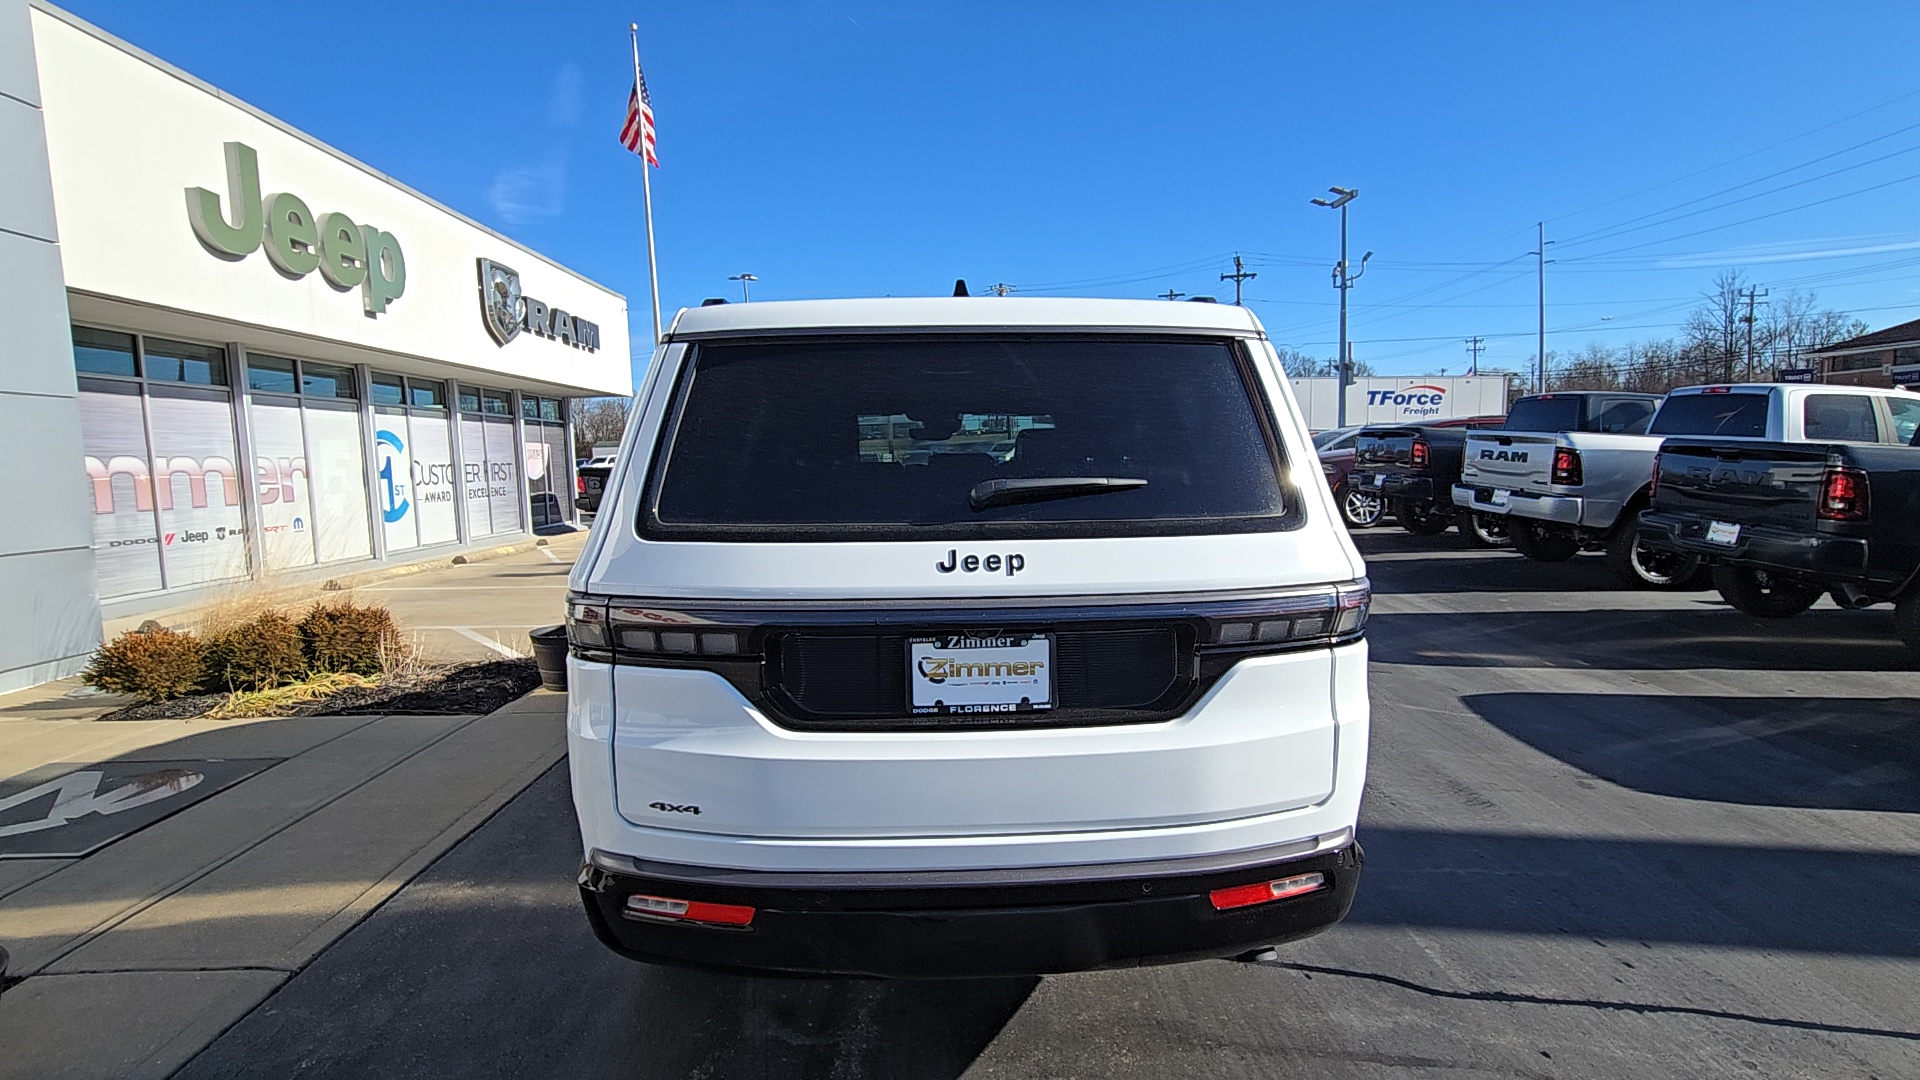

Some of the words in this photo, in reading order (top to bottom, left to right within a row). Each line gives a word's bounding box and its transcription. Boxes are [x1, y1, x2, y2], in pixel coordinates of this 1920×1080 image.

[184, 142, 406, 320] Jeep
[521, 296, 600, 354] RAM
[1367, 390, 1443, 406] TForce
[1402, 407, 1440, 416] Freight
[1480, 449, 1529, 463] RAM
[414, 460, 481, 486] CUSTOER
[1687, 466, 1774, 486] RAM
[424, 490, 451, 503] AWARD
[469, 486, 507, 500] EXCELENCE
[110, 538, 158, 548] DODG
[181, 530, 209, 543] Jeep
[229, 528, 244, 537] RA
[935, 549, 1025, 577] Jeep
[947, 635, 1014, 649] Zimmer
[926, 657, 1044, 678] Zimmer
[950, 704, 1017, 714] FLORENCE
